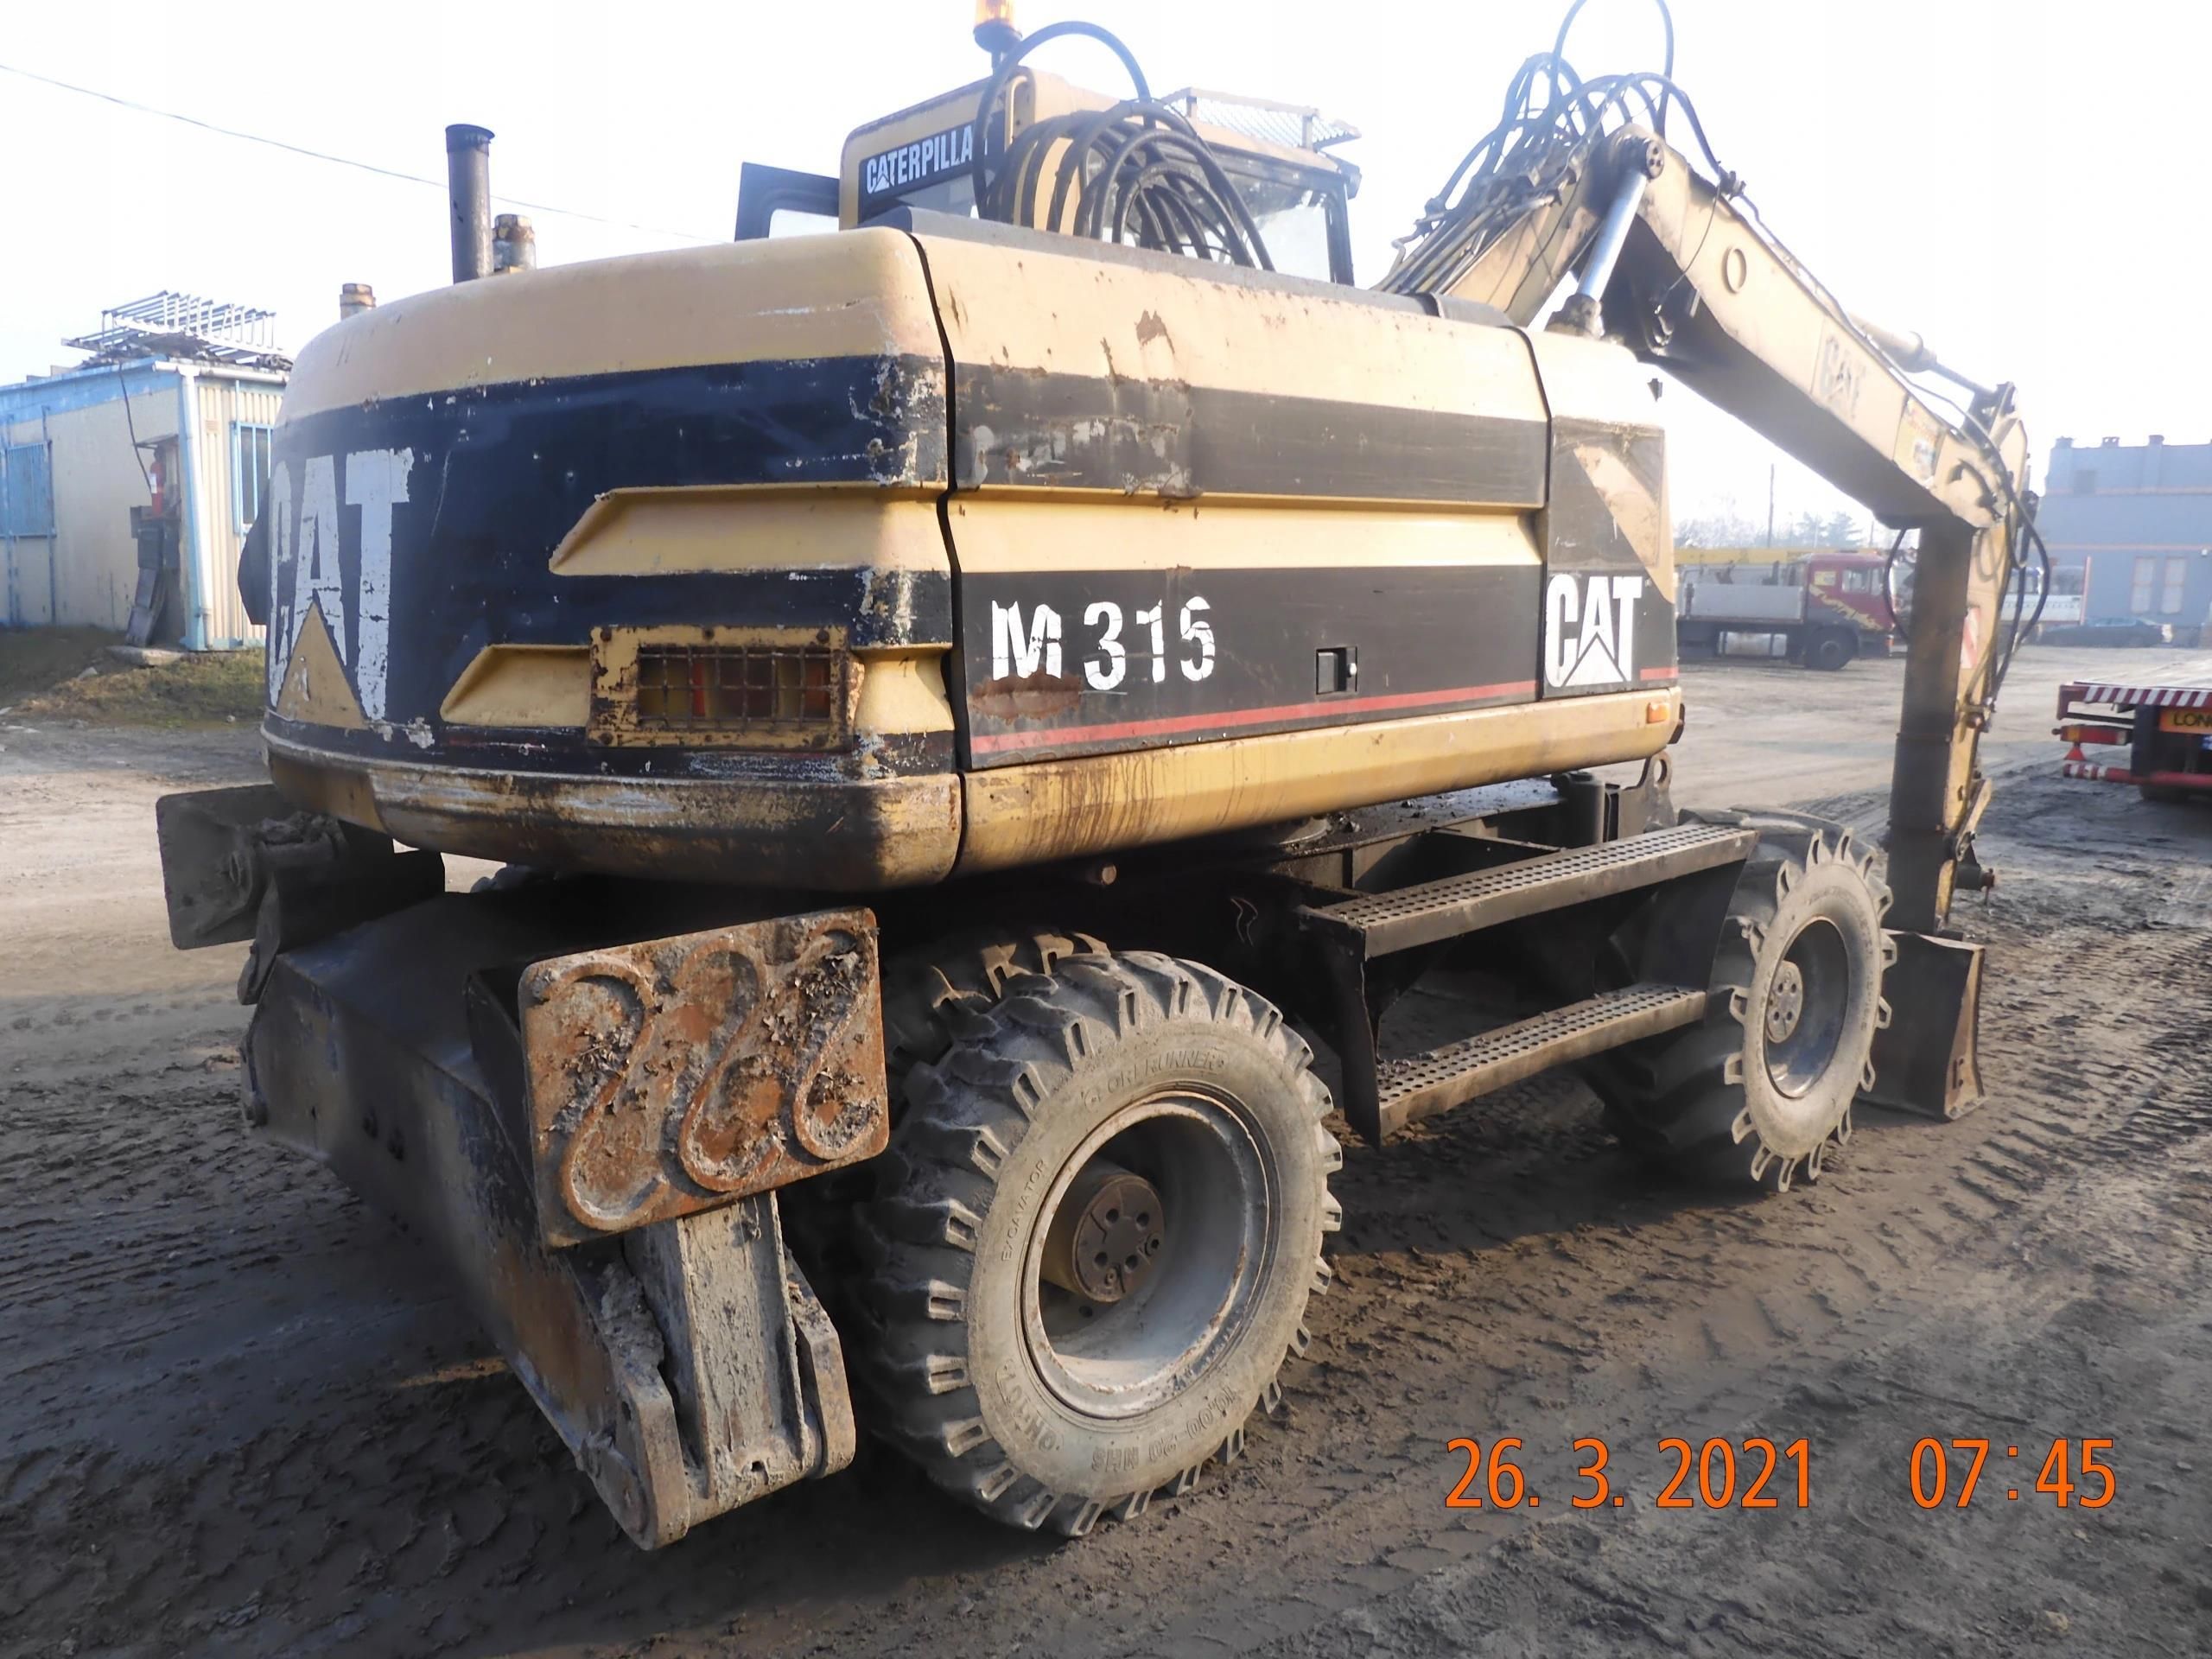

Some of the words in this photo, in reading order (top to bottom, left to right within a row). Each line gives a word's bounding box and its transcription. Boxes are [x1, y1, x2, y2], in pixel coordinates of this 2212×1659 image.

[867, 125, 987, 194] CATERPILLA
[268, 448, 414, 721] CAT
[1545, 574, 1643, 688] CAT
[992, 600, 1062, 681] M
[1001, 1159, 1044, 1262] EXCAVATOR
